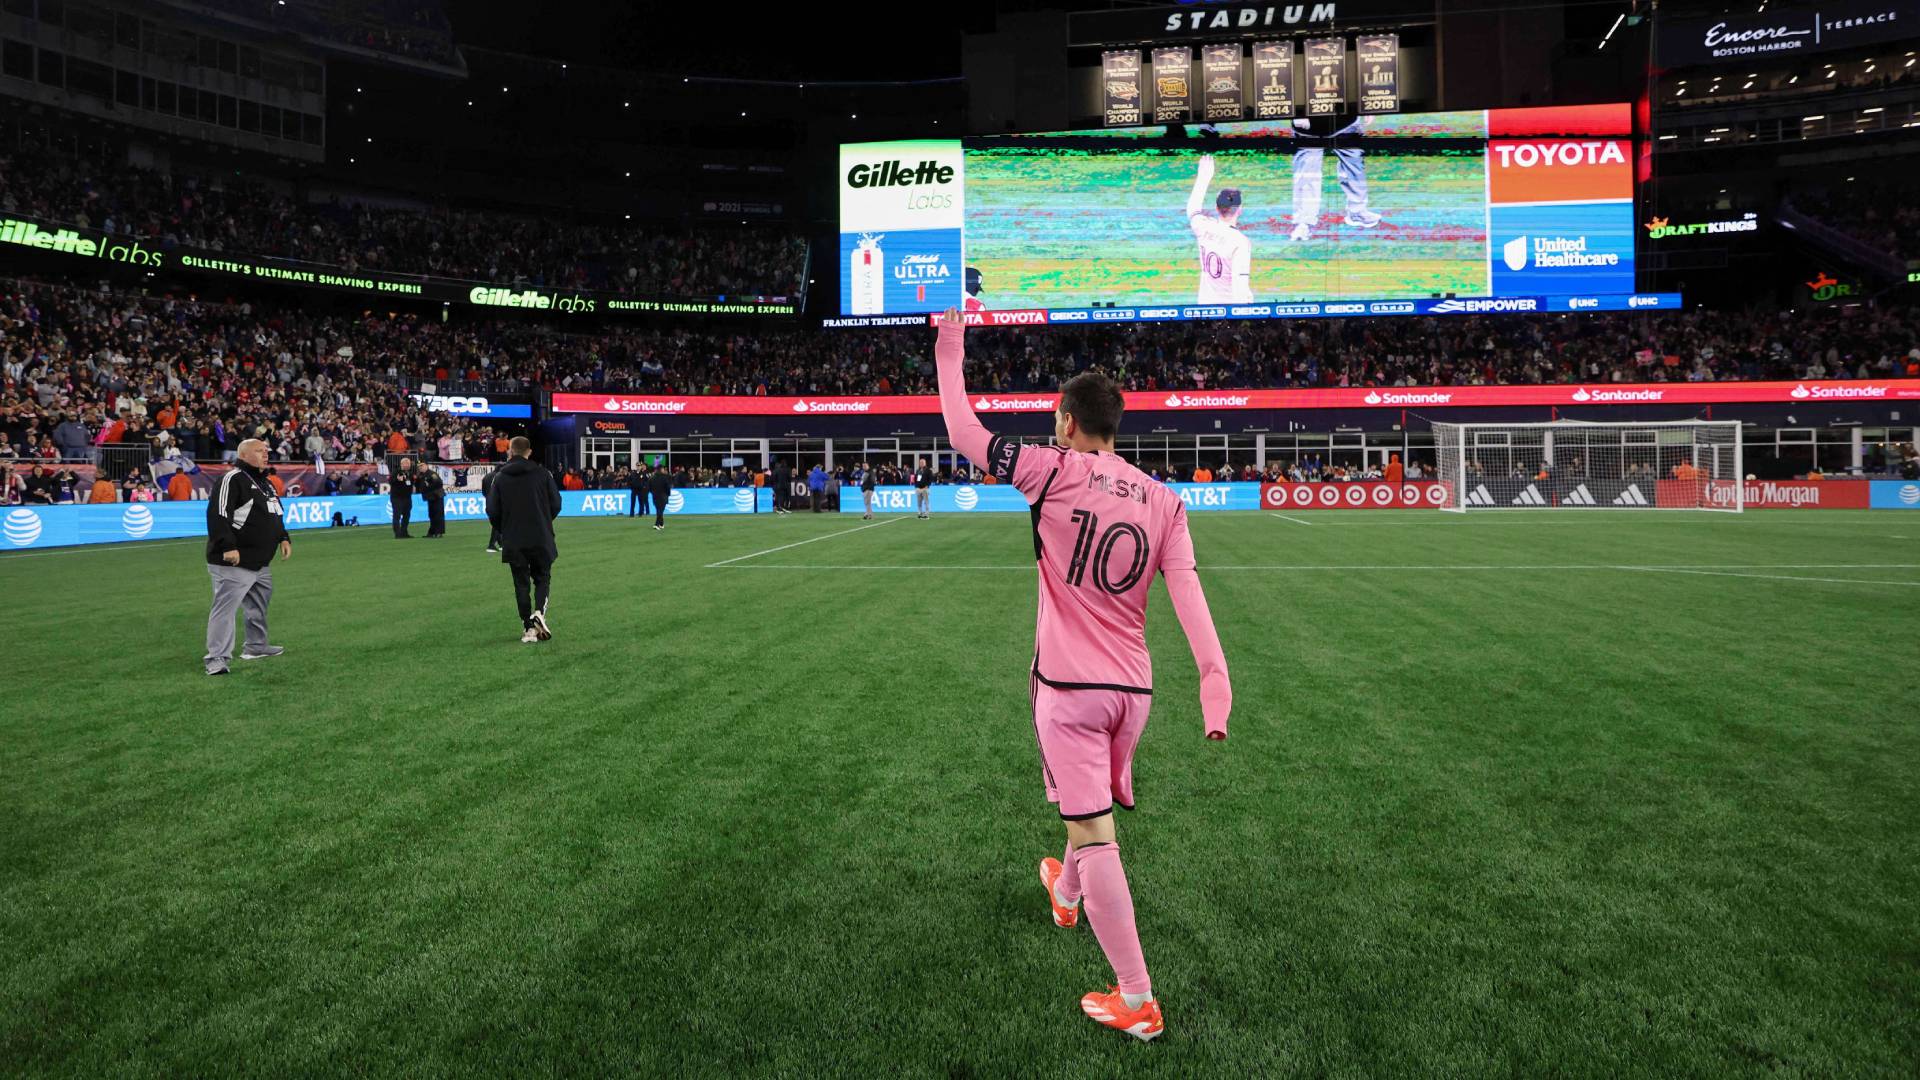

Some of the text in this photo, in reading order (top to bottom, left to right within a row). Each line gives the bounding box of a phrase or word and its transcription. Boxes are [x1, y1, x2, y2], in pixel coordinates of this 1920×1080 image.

[1165, 3, 1336, 31] STADIUM
[1825, 12, 1897, 30] TERRACE
[1704, 22, 1811, 47] Encore
[1713, 41, 1802, 57] BOSTON HARBOR
[1260, 106, 1289, 115] 2014
[1312, 103, 1334, 113] 201
[1365, 100, 1394, 110] 2018
[1108, 114, 1138, 123] 2001
[1157, 112, 1180, 120] 200
[1207, 109, 1240, 118] 2004
[1495, 141, 1625, 168] TOYOTA
[847, 160, 954, 188] Gillette
[1649, 220, 1757, 238] DRAFTKINGS
[0, 219, 97, 256] illette
[1534, 236, 1587, 253] United
[1534, 252, 1619, 267] Healthcare
[182, 256, 251, 274] GILLETTE'S
[255, 267, 315, 282] ULTIMATE
[319, 275, 374, 289] SHAVING
[895, 264, 951, 278] ULTRA
[470, 287, 550, 309] Gillette
[1578, 298, 1599, 307] UHC
[1637, 297, 1658, 306] UHC
[608, 301, 659, 310] GILLETTE'S
[663, 303, 708, 312] ULTIMATE
[711, 305, 754, 313] SHAVING
[1231, 306, 1271, 316] GEICO
[1325, 304, 1365, 313] GEICO
[1466, 299, 1536, 311] EMPOWER
[993, 312, 1045, 324] TOYOTA
[1051, 312, 1088, 321] GEICO
[1140, 309, 1178, 317] GEICO
[823, 317, 926, 327] FRANKLIN TEMPLETON
[1592, 389, 1663, 401] Santander
[1811, 386, 1885, 398] Santander
[992, 399, 1054, 410] Santander
[1183, 395, 1248, 407] Santander
[1383, 393, 1451, 404] Santander
[621, 400, 686, 411] Santander
[809, 401, 870, 412] Santander
[595, 421, 625, 431] Optum
[1088, 470, 1147, 504] MESSI
[871, 490, 916, 508] AT&T
[1180, 487, 1231, 506] AT&T
[1705, 482, 1819, 507] Captin Morgan
[582, 494, 626, 511] AT&T
[286, 502, 334, 523] AT&T
[1066, 509, 1149, 595] 10
